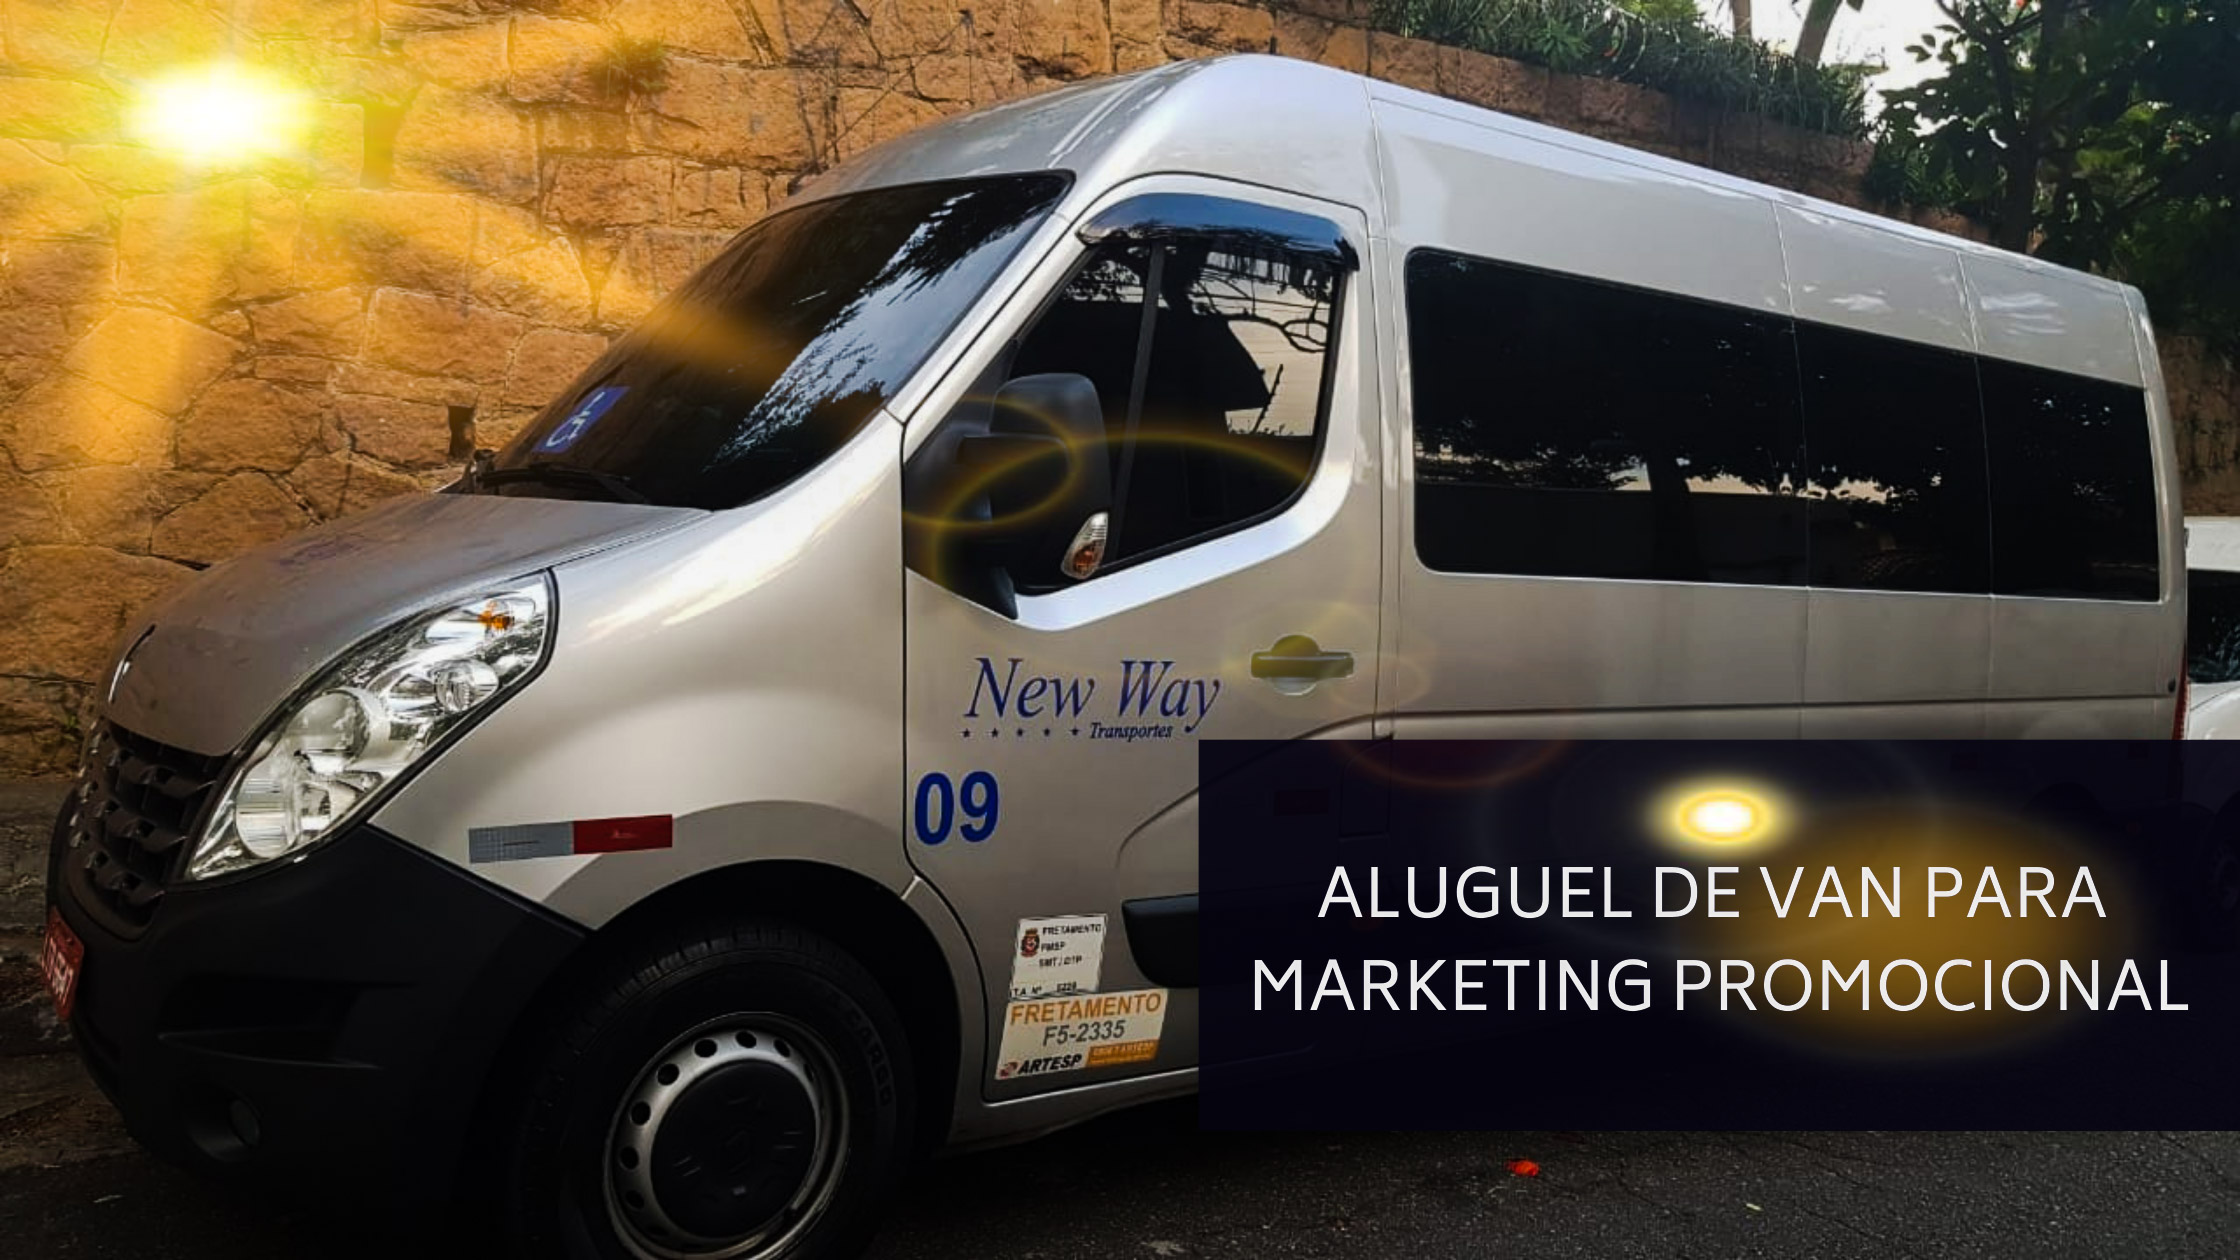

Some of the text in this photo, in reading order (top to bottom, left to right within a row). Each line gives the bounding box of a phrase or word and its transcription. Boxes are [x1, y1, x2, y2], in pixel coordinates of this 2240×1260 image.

[963, 657, 1220, 733] New Way
[1089, 722, 1173, 742] Transportes
[914, 771, 999, 845] 09
[1042, 923, 1102, 935] FRETAMENTO
[1010, 992, 1161, 1026] FRETAMENTO
[1043, 1019, 1126, 1047] F5-2335
[1017, 1053, 1083, 1075] ARTESP
